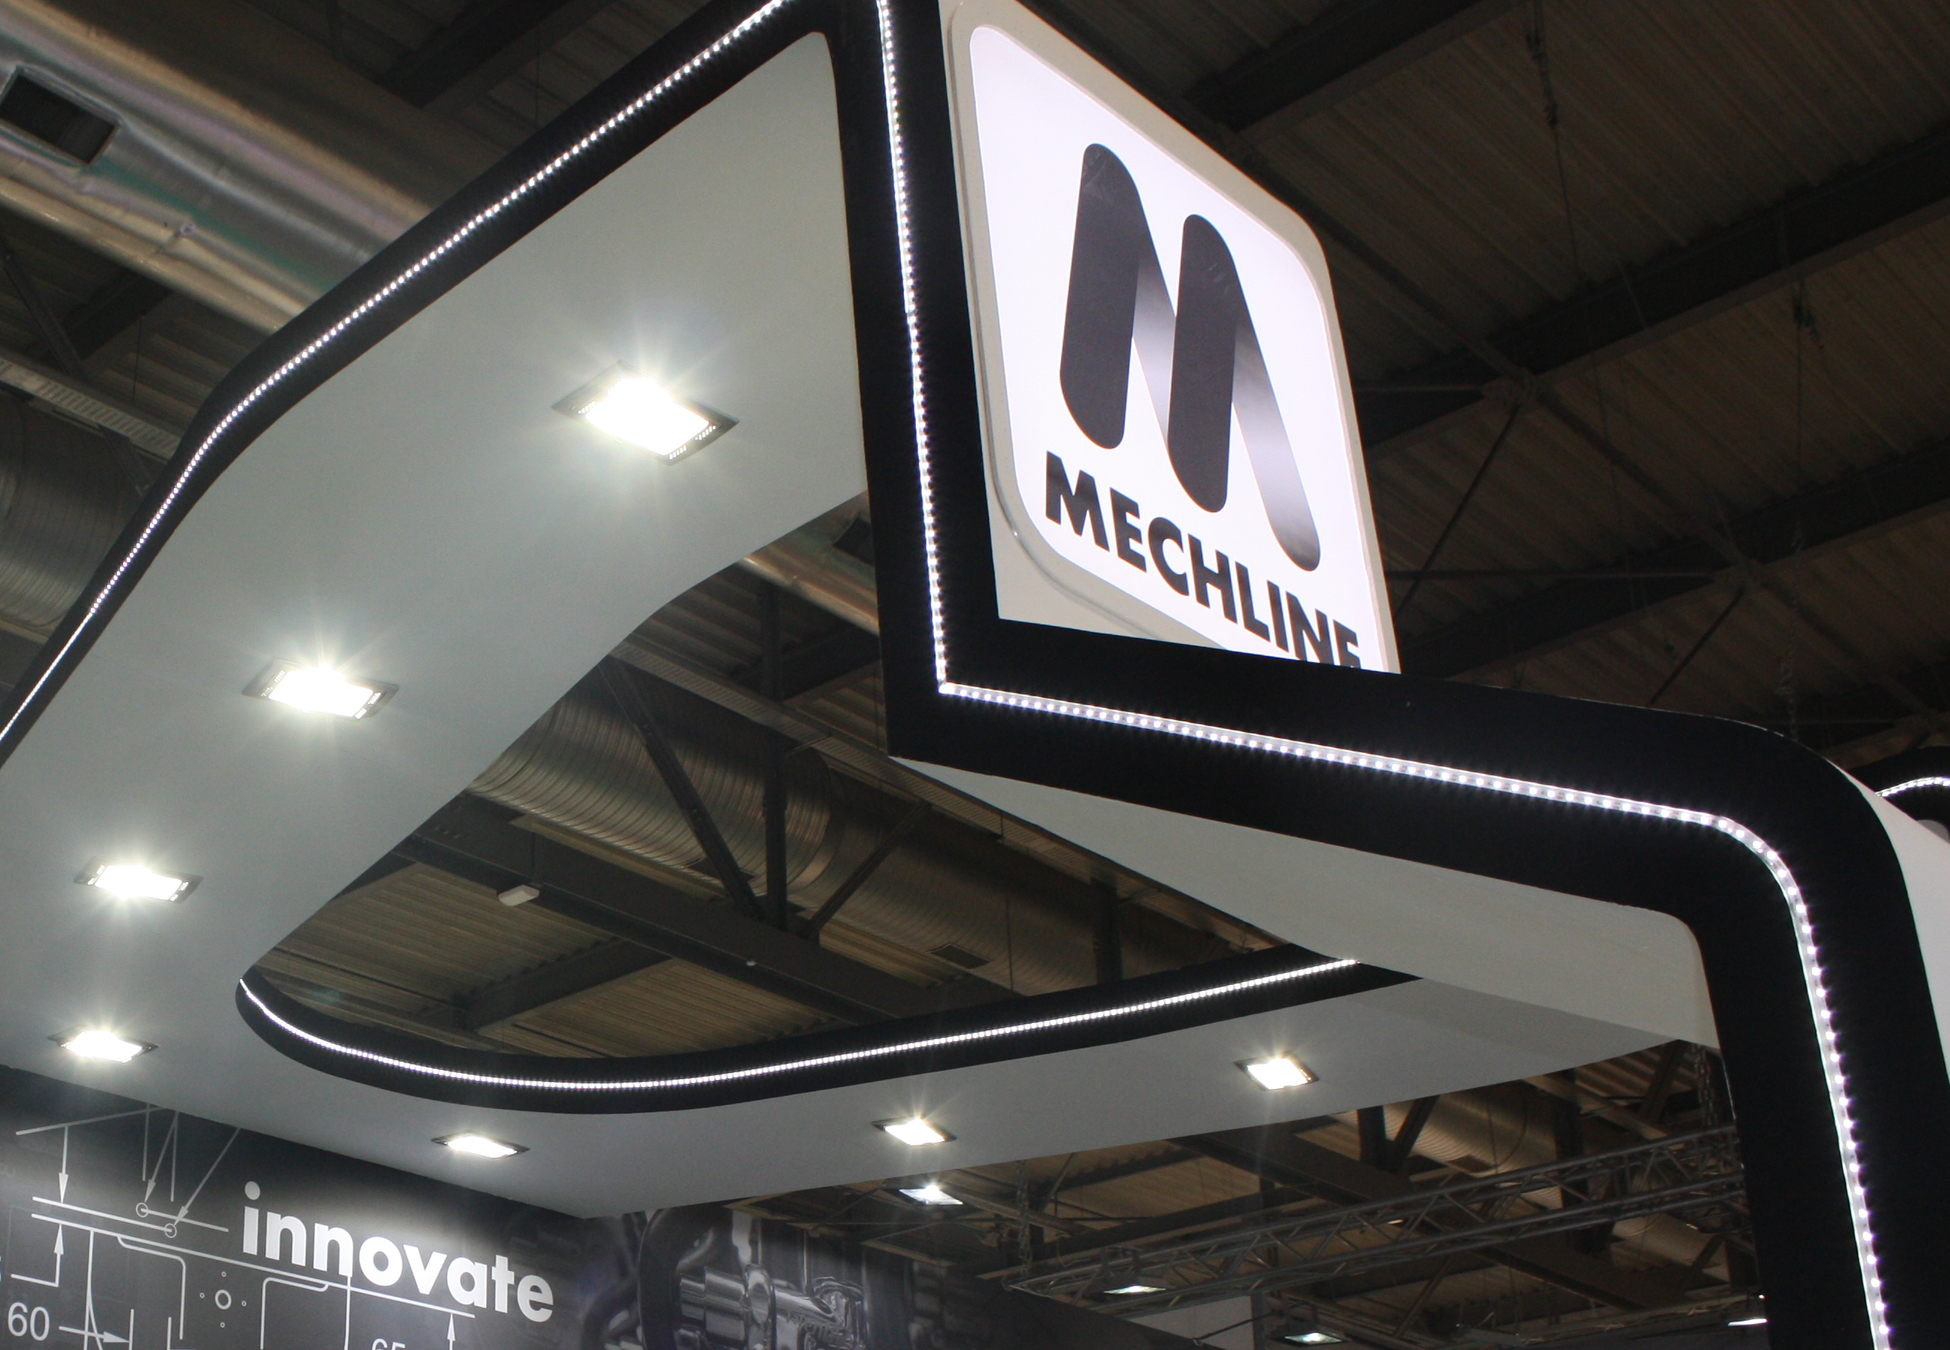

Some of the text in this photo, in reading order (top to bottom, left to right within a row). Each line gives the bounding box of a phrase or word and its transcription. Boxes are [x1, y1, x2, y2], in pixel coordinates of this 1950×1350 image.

[1046, 450, 1362, 669] MECHLINE
[7, 1301, 51, 1342] 60
[242, 1181, 554, 1322] innovate
